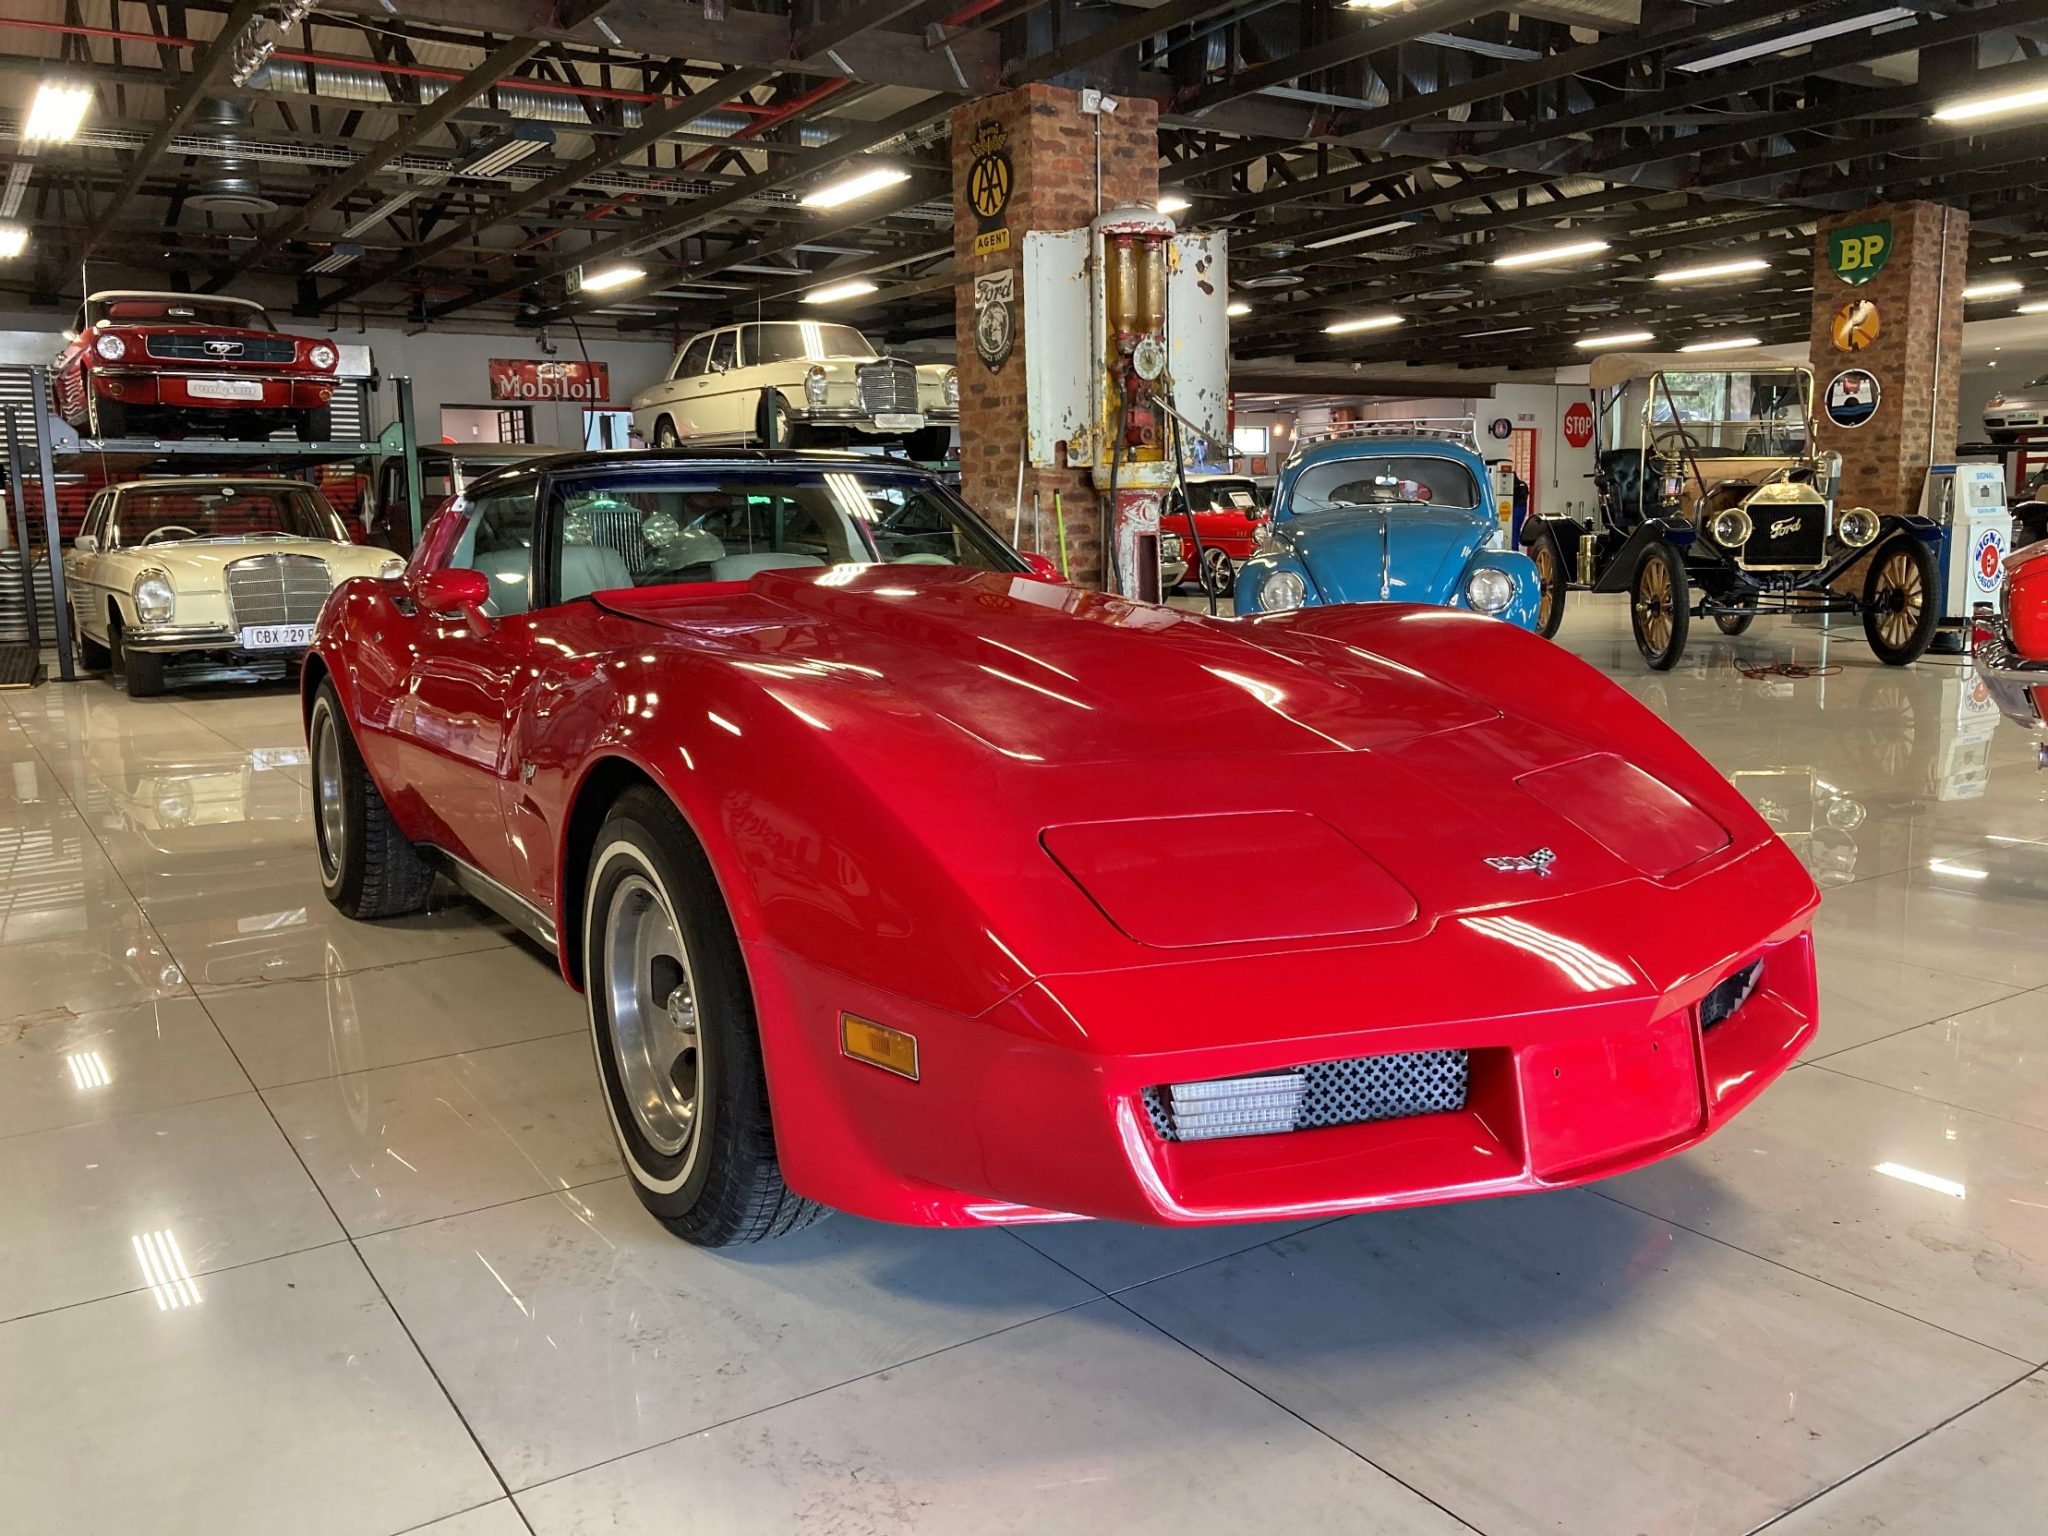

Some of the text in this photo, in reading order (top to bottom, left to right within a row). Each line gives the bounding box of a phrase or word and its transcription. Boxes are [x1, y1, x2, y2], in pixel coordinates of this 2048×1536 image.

[977, 231, 1008, 249] AGENT
[1838, 234, 1884, 271] BP
[975, 275, 1012, 304] Ford
[498, 374, 602, 399] Mobiloil
[1566, 416, 1593, 436] STOP
[1770, 516, 1802, 539] Ford
[1975, 532, 2005, 561] SIGNAL
[256, 630, 279, 644] CBX
[282, 629, 305, 643] 229
